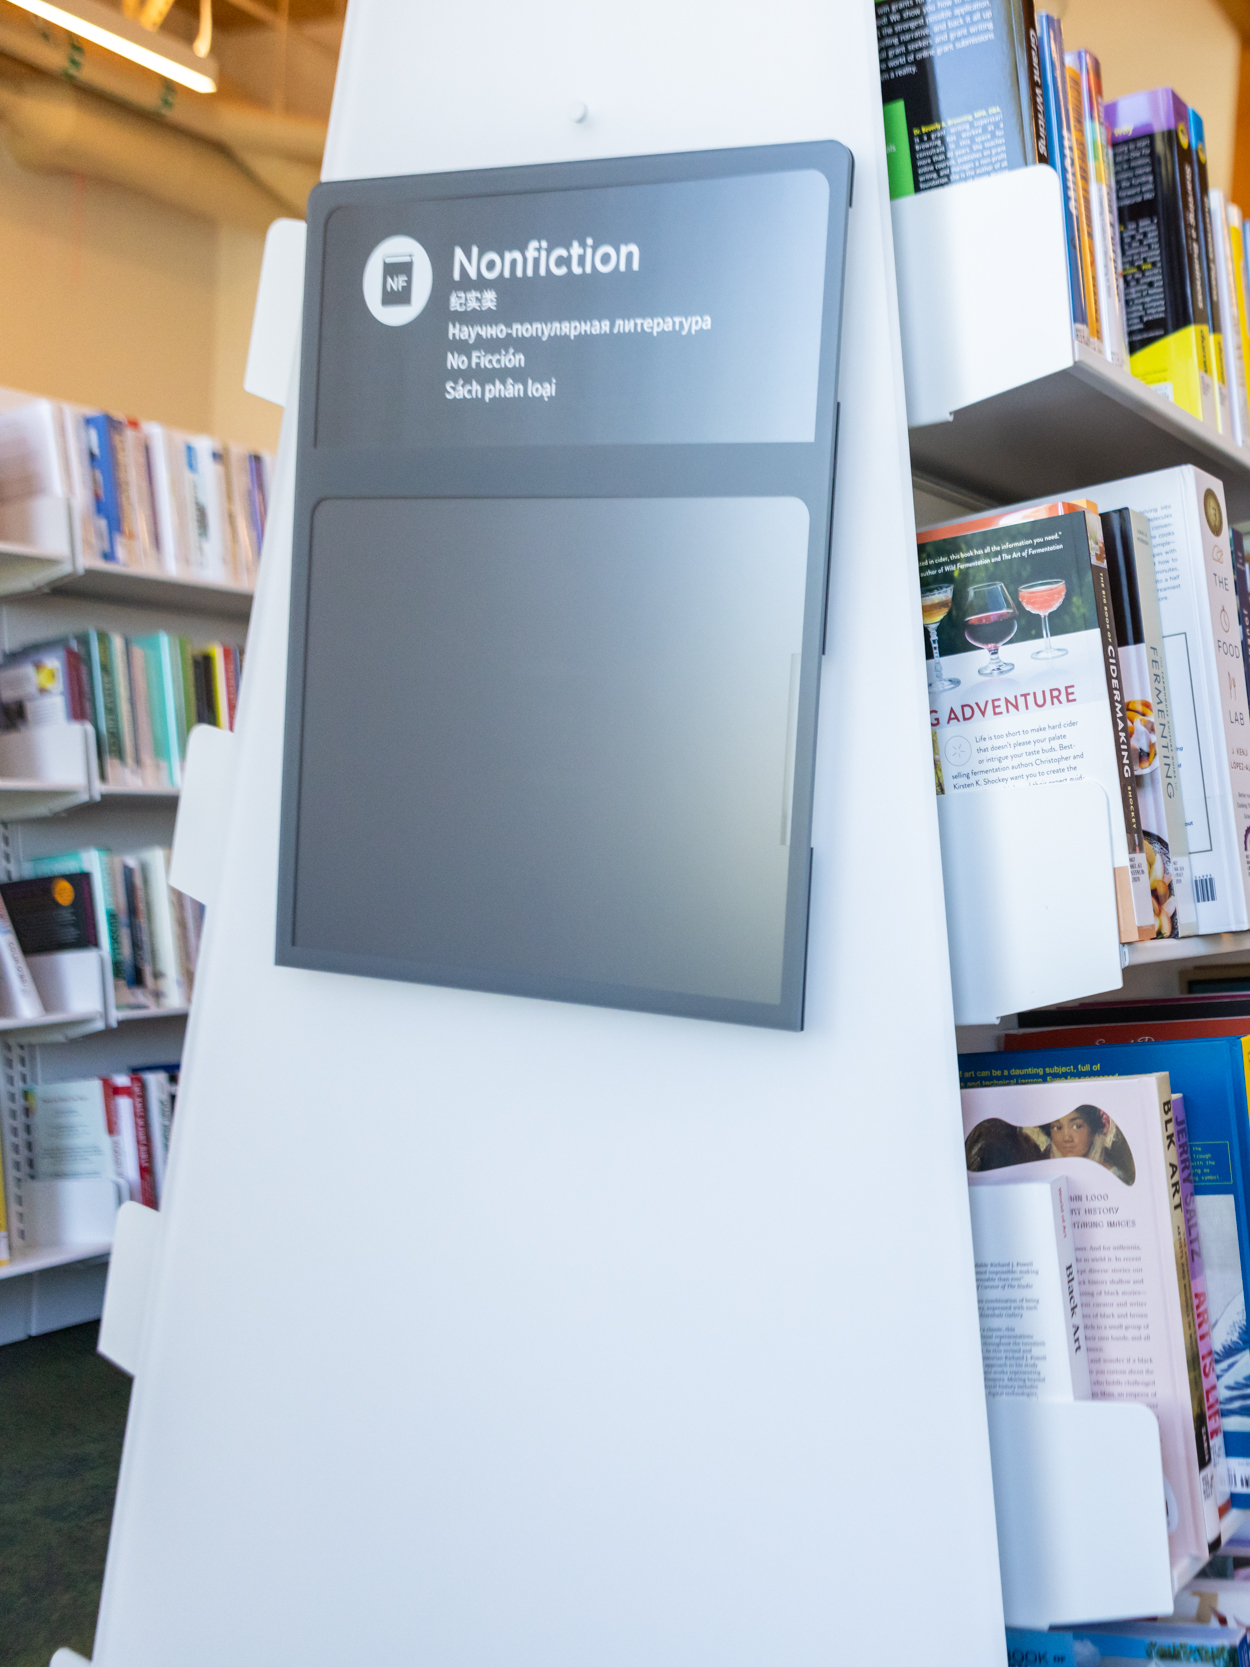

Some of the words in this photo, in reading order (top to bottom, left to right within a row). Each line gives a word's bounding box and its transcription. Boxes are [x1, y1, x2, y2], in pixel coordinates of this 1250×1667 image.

[893, 16, 924, 34] strongest
[901, 6, 921, 19] show
[1029, 28, 1043, 82] Grant
[1036, 88, 1048, 158] Writing
[452, 238, 640, 281] Nonfiction
[386, 276, 408, 292] NF
[449, 288, 497, 312] 纪实类
[448, 319, 610, 345] Научно-популярная
[613, 313, 712, 335] литература
[446, 351, 468, 370] No
[471, 347, 525, 369] Ficción
[445, 378, 481, 400] Sách
[484, 379, 524, 403] phân
[528, 377, 557, 401] loại
[934, 554, 950, 564] cider,
[950, 552, 961, 561] this
[960, 550, 974, 560] book
[974, 548, 984, 556] has
[991, 544, 1001, 553] the
[1001, 539, 1033, 550] information
[1033, 538, 1044, 547] you
[944, 564, 957, 573] Wild
[957, 558, 991, 570] Fermentation
[992, 556, 1002, 564] and
[1002, 552, 1012, 561] The
[1012, 551, 1022, 559] Art
[1028, 543, 1064, 556] Fermentation
[1213, 572, 1230, 592] THE
[1217, 640, 1240, 660] FOOD
[946, 684, 1078, 724] ADVENTURE
[1102, 605, 1110, 630] BOOK
[1107, 645, 1131, 779] CIDERMAKING
[1127, 785, 1138, 830] SHOCKEY
[1150, 646, 1174, 800] FERMENTING
[1228, 710, 1245, 726] LAB
[974, 736, 987, 744] Life
[1006, 730, 1022, 739] short
[1022, 728, 1029, 736] to
[1030, 725, 1047, 735] make
[1048, 722, 1062, 731] hard
[1062, 720, 1079, 729] cider
[976, 746, 990, 755] that
[1013, 739, 1033, 751] please
[1034, 737, 1048, 747] your
[1048, 733, 1067, 745] palate
[951, 771, 971, 783] selling
[971, 764, 1010, 778] fermentation
[1011, 760, 1034, 771] authors
[1034, 755, 1072, 769] Christopher
[1072, 752, 1085, 760] and
[986, 754, 1009, 766] intrigue
[1010, 752, 1024, 762] your
[1024, 749, 1040, 757] taste
[1042, 746, 1058, 755] buds.
[1058, 743, 1076, 752] Best-
[953, 780, 975, 791] Kirsten
[984, 776, 1009, 788] Shockey
[1025, 772, 1038, 781] you
[1046, 767, 1066, 776] create
[1066, 764, 1078, 772] the
[964, 1071, 975, 1079] art
[976, 1070, 991, 1078] can
[991, 1068, 1002, 1077] be
[1010, 1066, 1044, 1077] daunting
[1044, 1065, 1077, 1075] subject,
[1077, 1064, 1091, 1072] full
[1092, 1062, 1101, 1071] of
[1162, 1100, 1176, 1150] BLK
[1085, 1193, 1109, 1203] 1,000
[1168, 1160, 1183, 1213] ART
[1174, 1114, 1193, 1186] JERRY
[1184, 1192, 1201, 1263] SALTZ
[1084, 1206, 1120, 1216] HISTORY
[1106, 1220, 1137, 1229] IMAGES
[1066, 1263, 1080, 1319] Black
[1194, 1291, 1207, 1339] ART
[1072, 1322, 1082, 1355] Art
[1200, 1348, 1212, 1380] IS
[1204, 1384, 1222, 1441] LIFE
